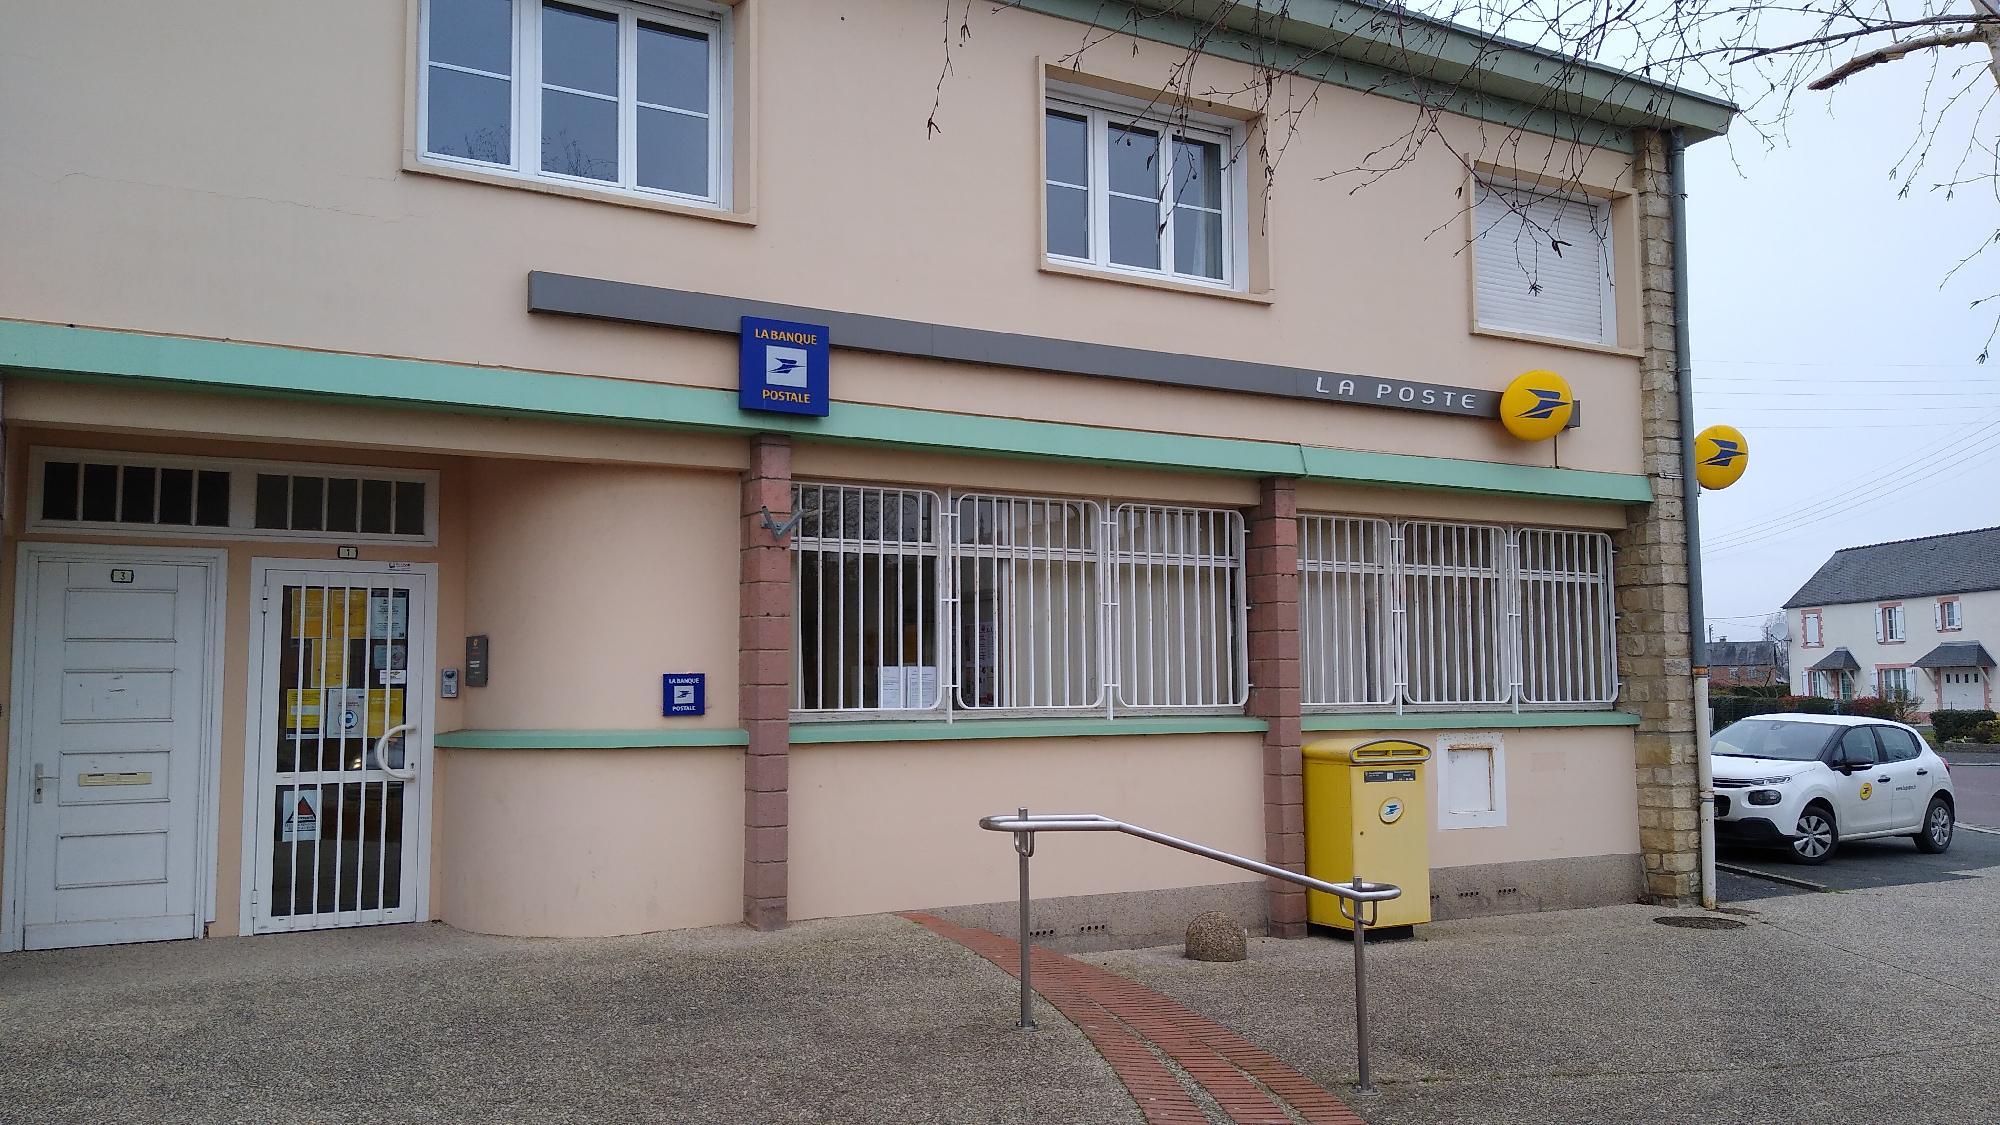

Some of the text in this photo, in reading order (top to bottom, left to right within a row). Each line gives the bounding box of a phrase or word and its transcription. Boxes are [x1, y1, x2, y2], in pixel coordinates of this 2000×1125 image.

[755, 328, 817, 345] LA BANQUE
[762, 389, 811, 404] POSTALE
[1316, 376, 1476, 409] LA POSTE
[120, 571, 126, 581] 3
